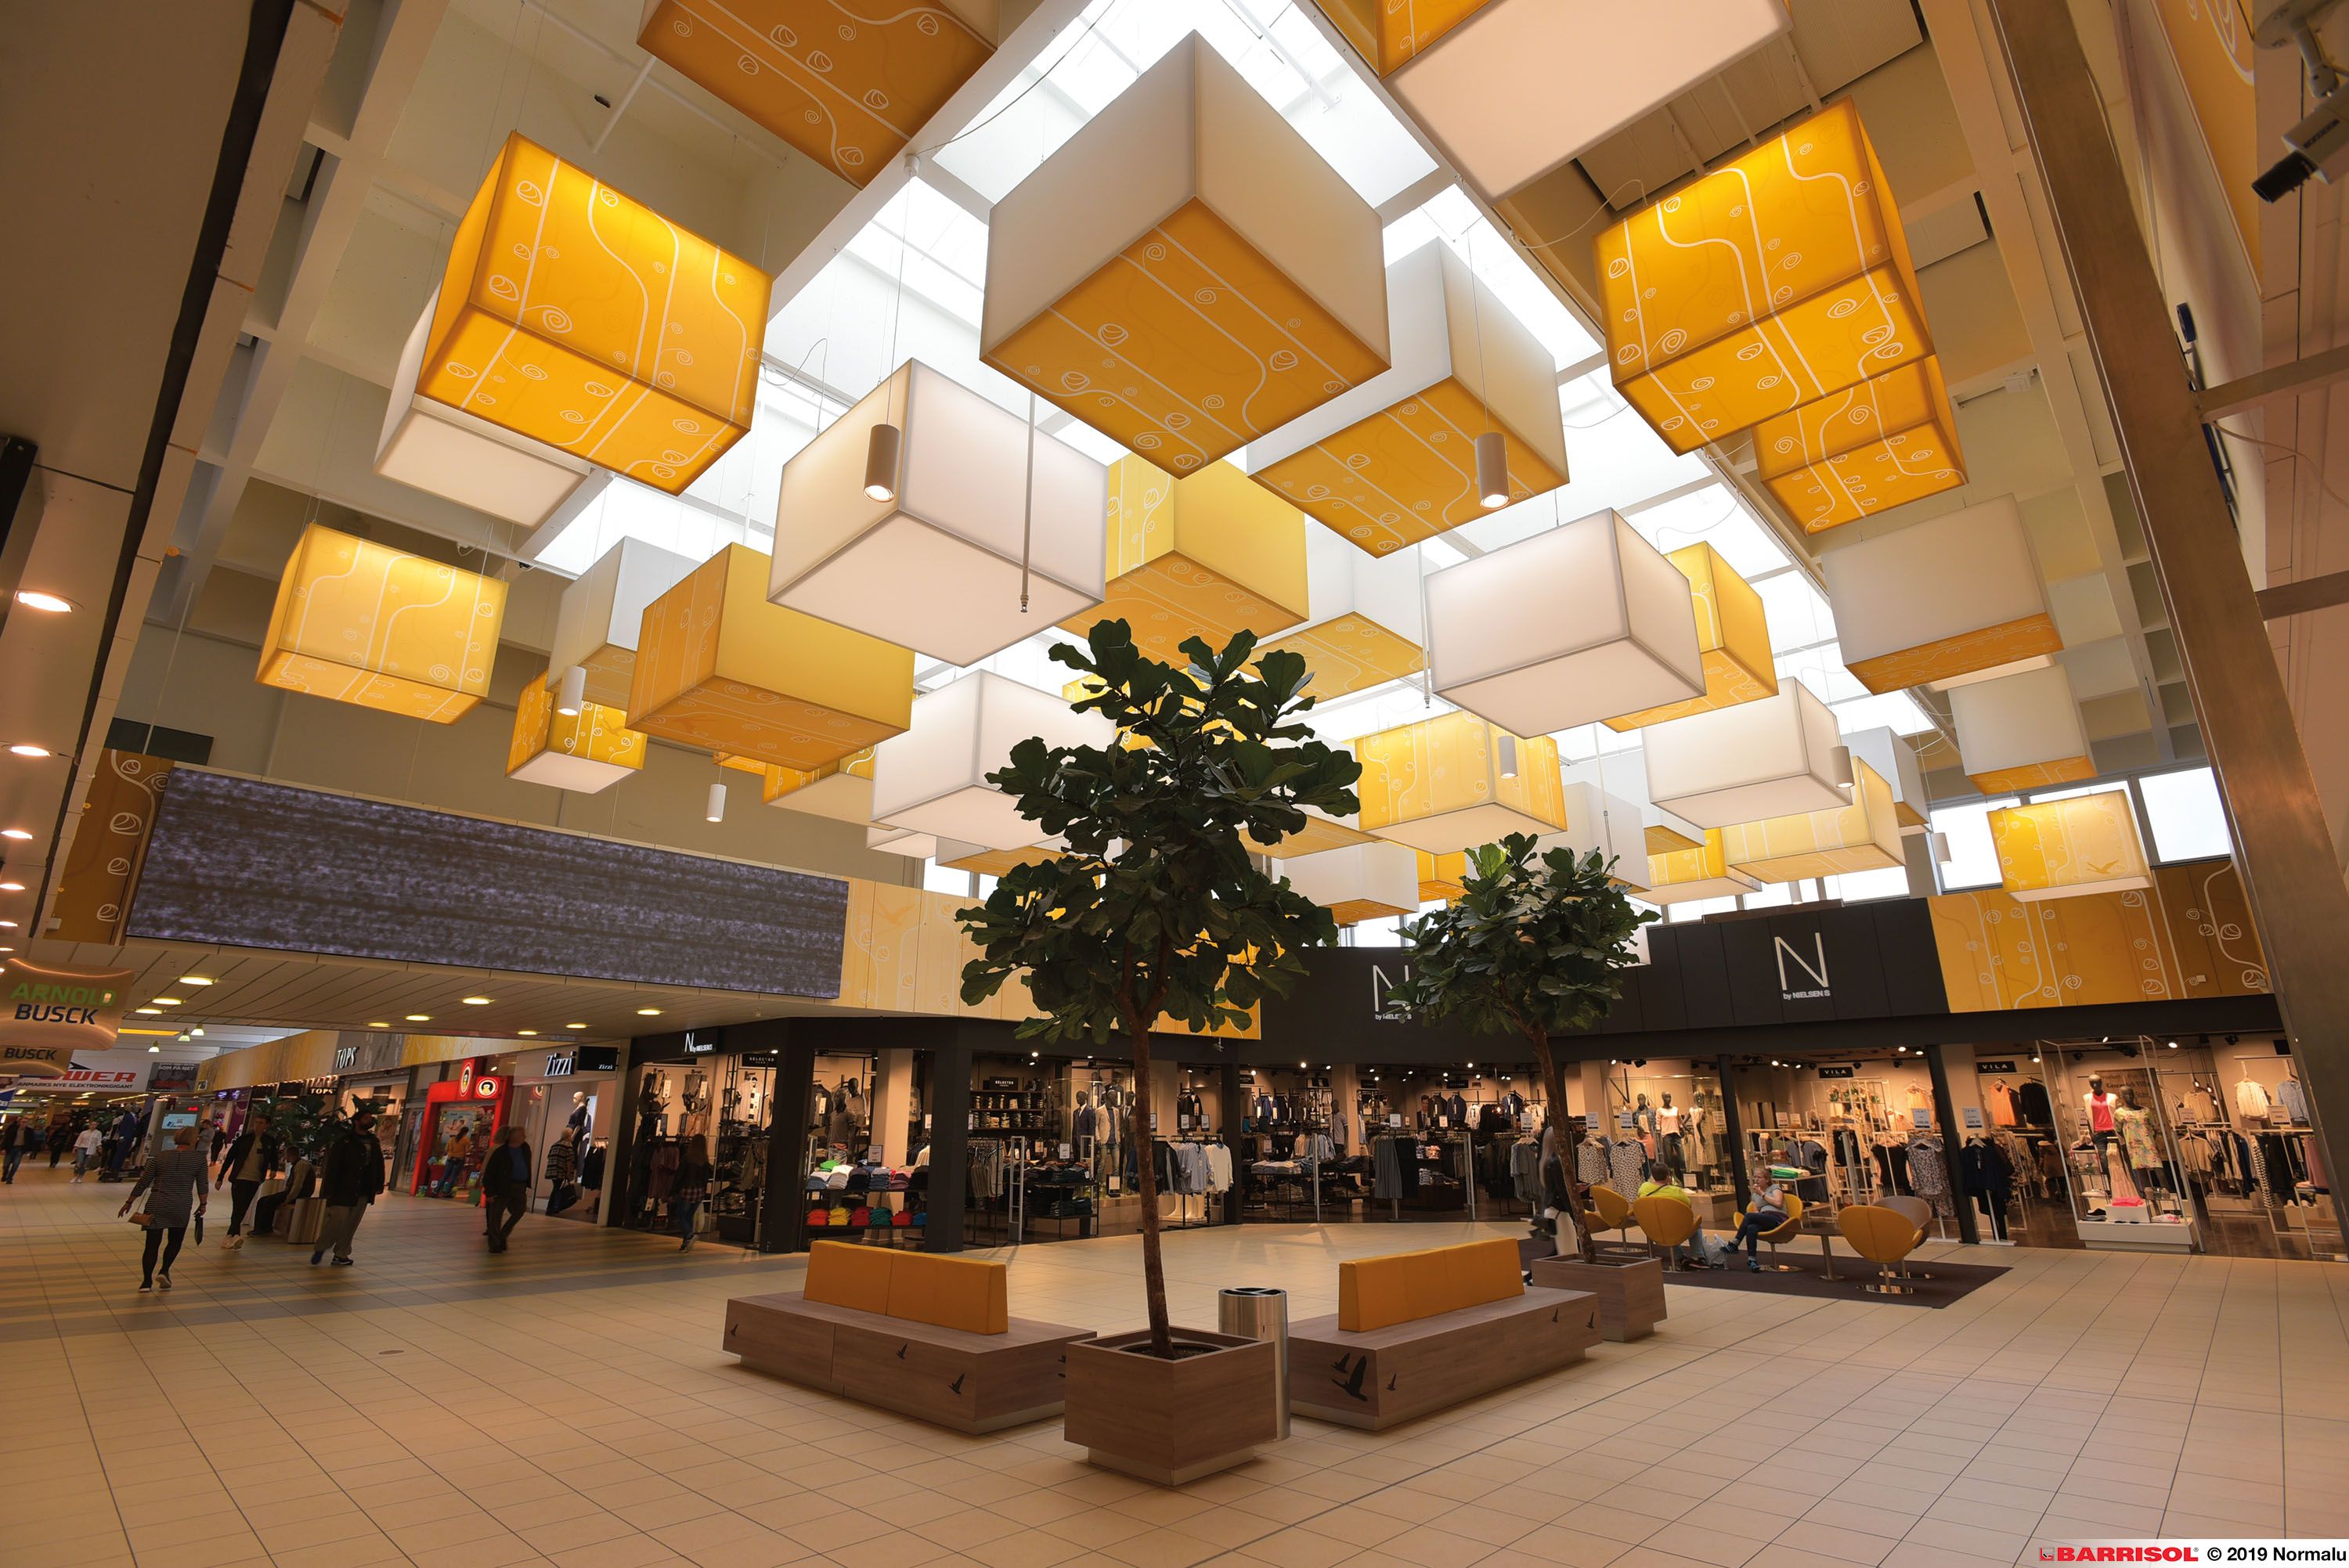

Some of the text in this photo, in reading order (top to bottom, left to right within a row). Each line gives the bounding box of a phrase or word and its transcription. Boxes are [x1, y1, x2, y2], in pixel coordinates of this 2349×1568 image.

[1774, 932, 1829, 990] N
[9, 982, 117, 1007] ARNOLD
[1373, 964, 1411, 1011] N
[14, 1004, 99, 1025] BUSCK
[4, 1047, 57, 1060] BUSCK
[684, 1032, 695, 1053] N
[336, 1046, 357, 1069] TOPS
[544, 1051, 577, 1076] Zizzi
